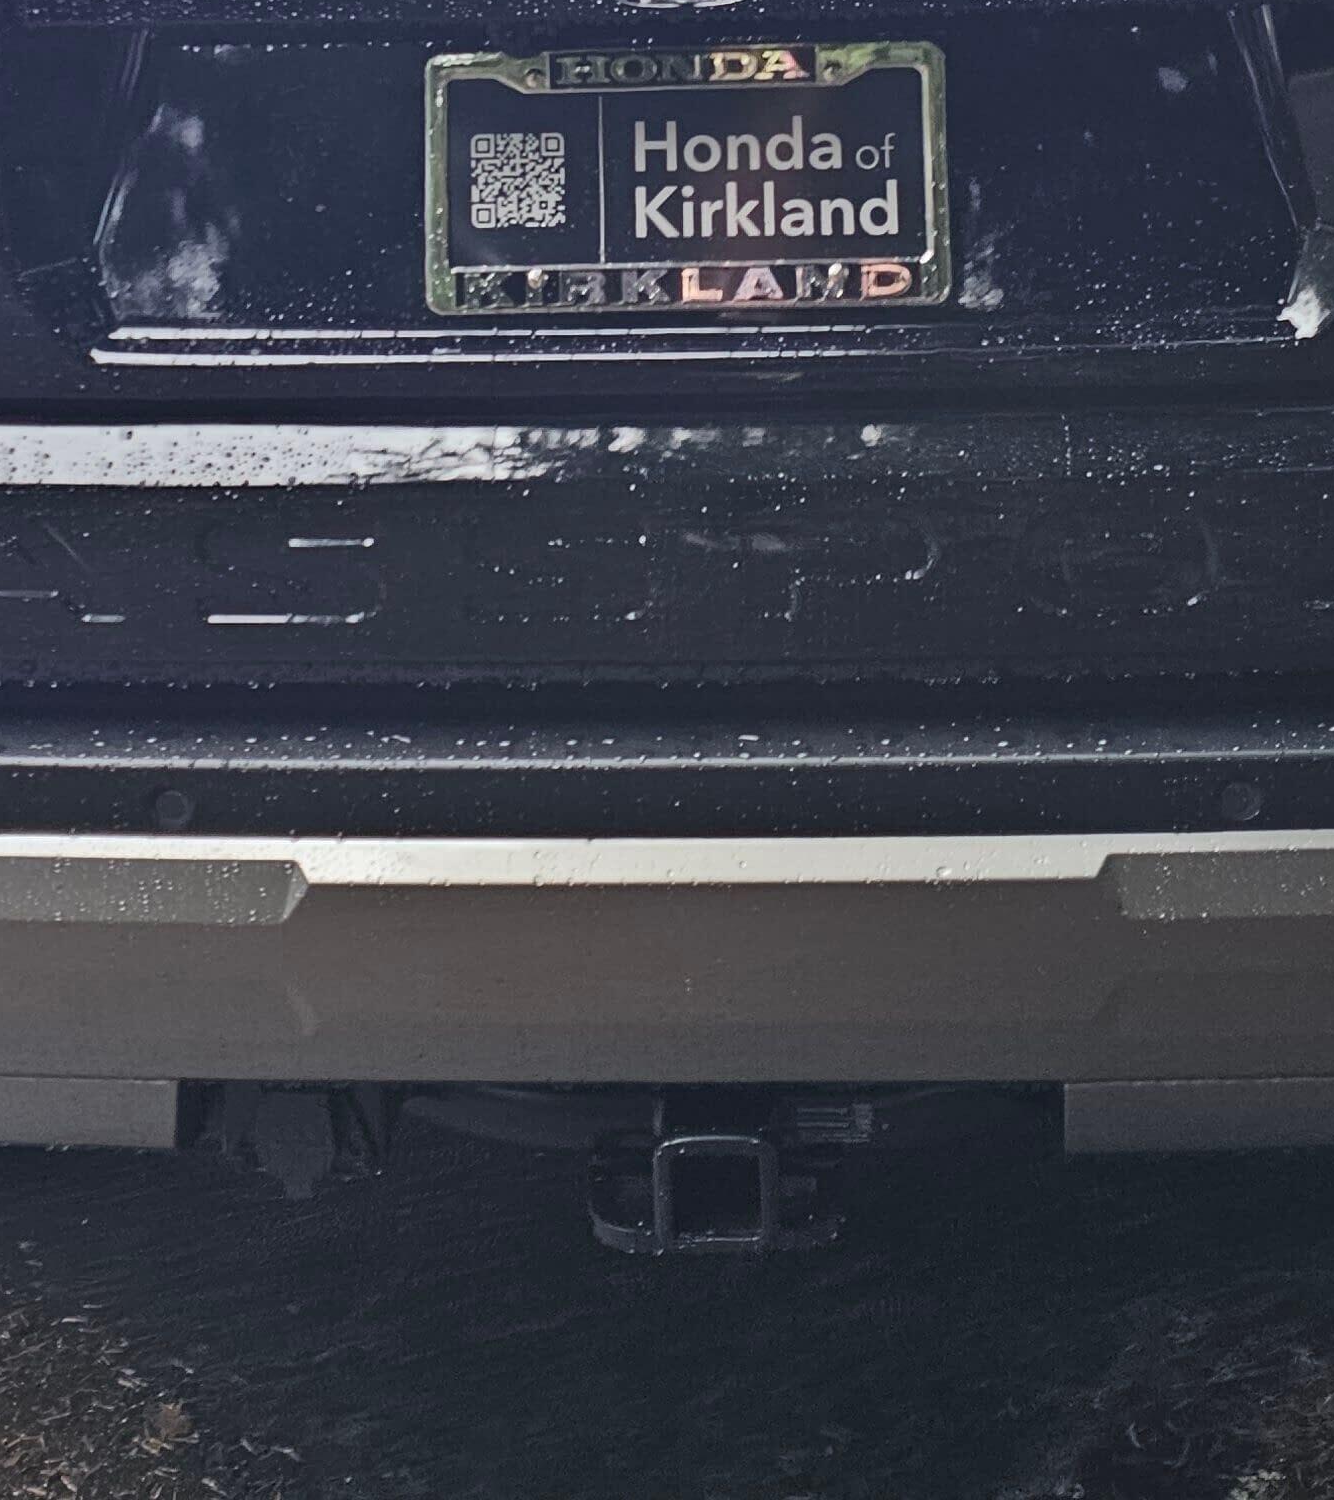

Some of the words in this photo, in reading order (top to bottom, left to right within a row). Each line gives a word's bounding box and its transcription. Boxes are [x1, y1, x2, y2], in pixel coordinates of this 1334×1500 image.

[555, 50, 811, 85] HONDA
[633, 116, 842, 173] Honda
[855, 132, 896, 171] of
[634, 180, 899, 239] Kirkland
[463, 262, 913, 306] KIRKLAND
